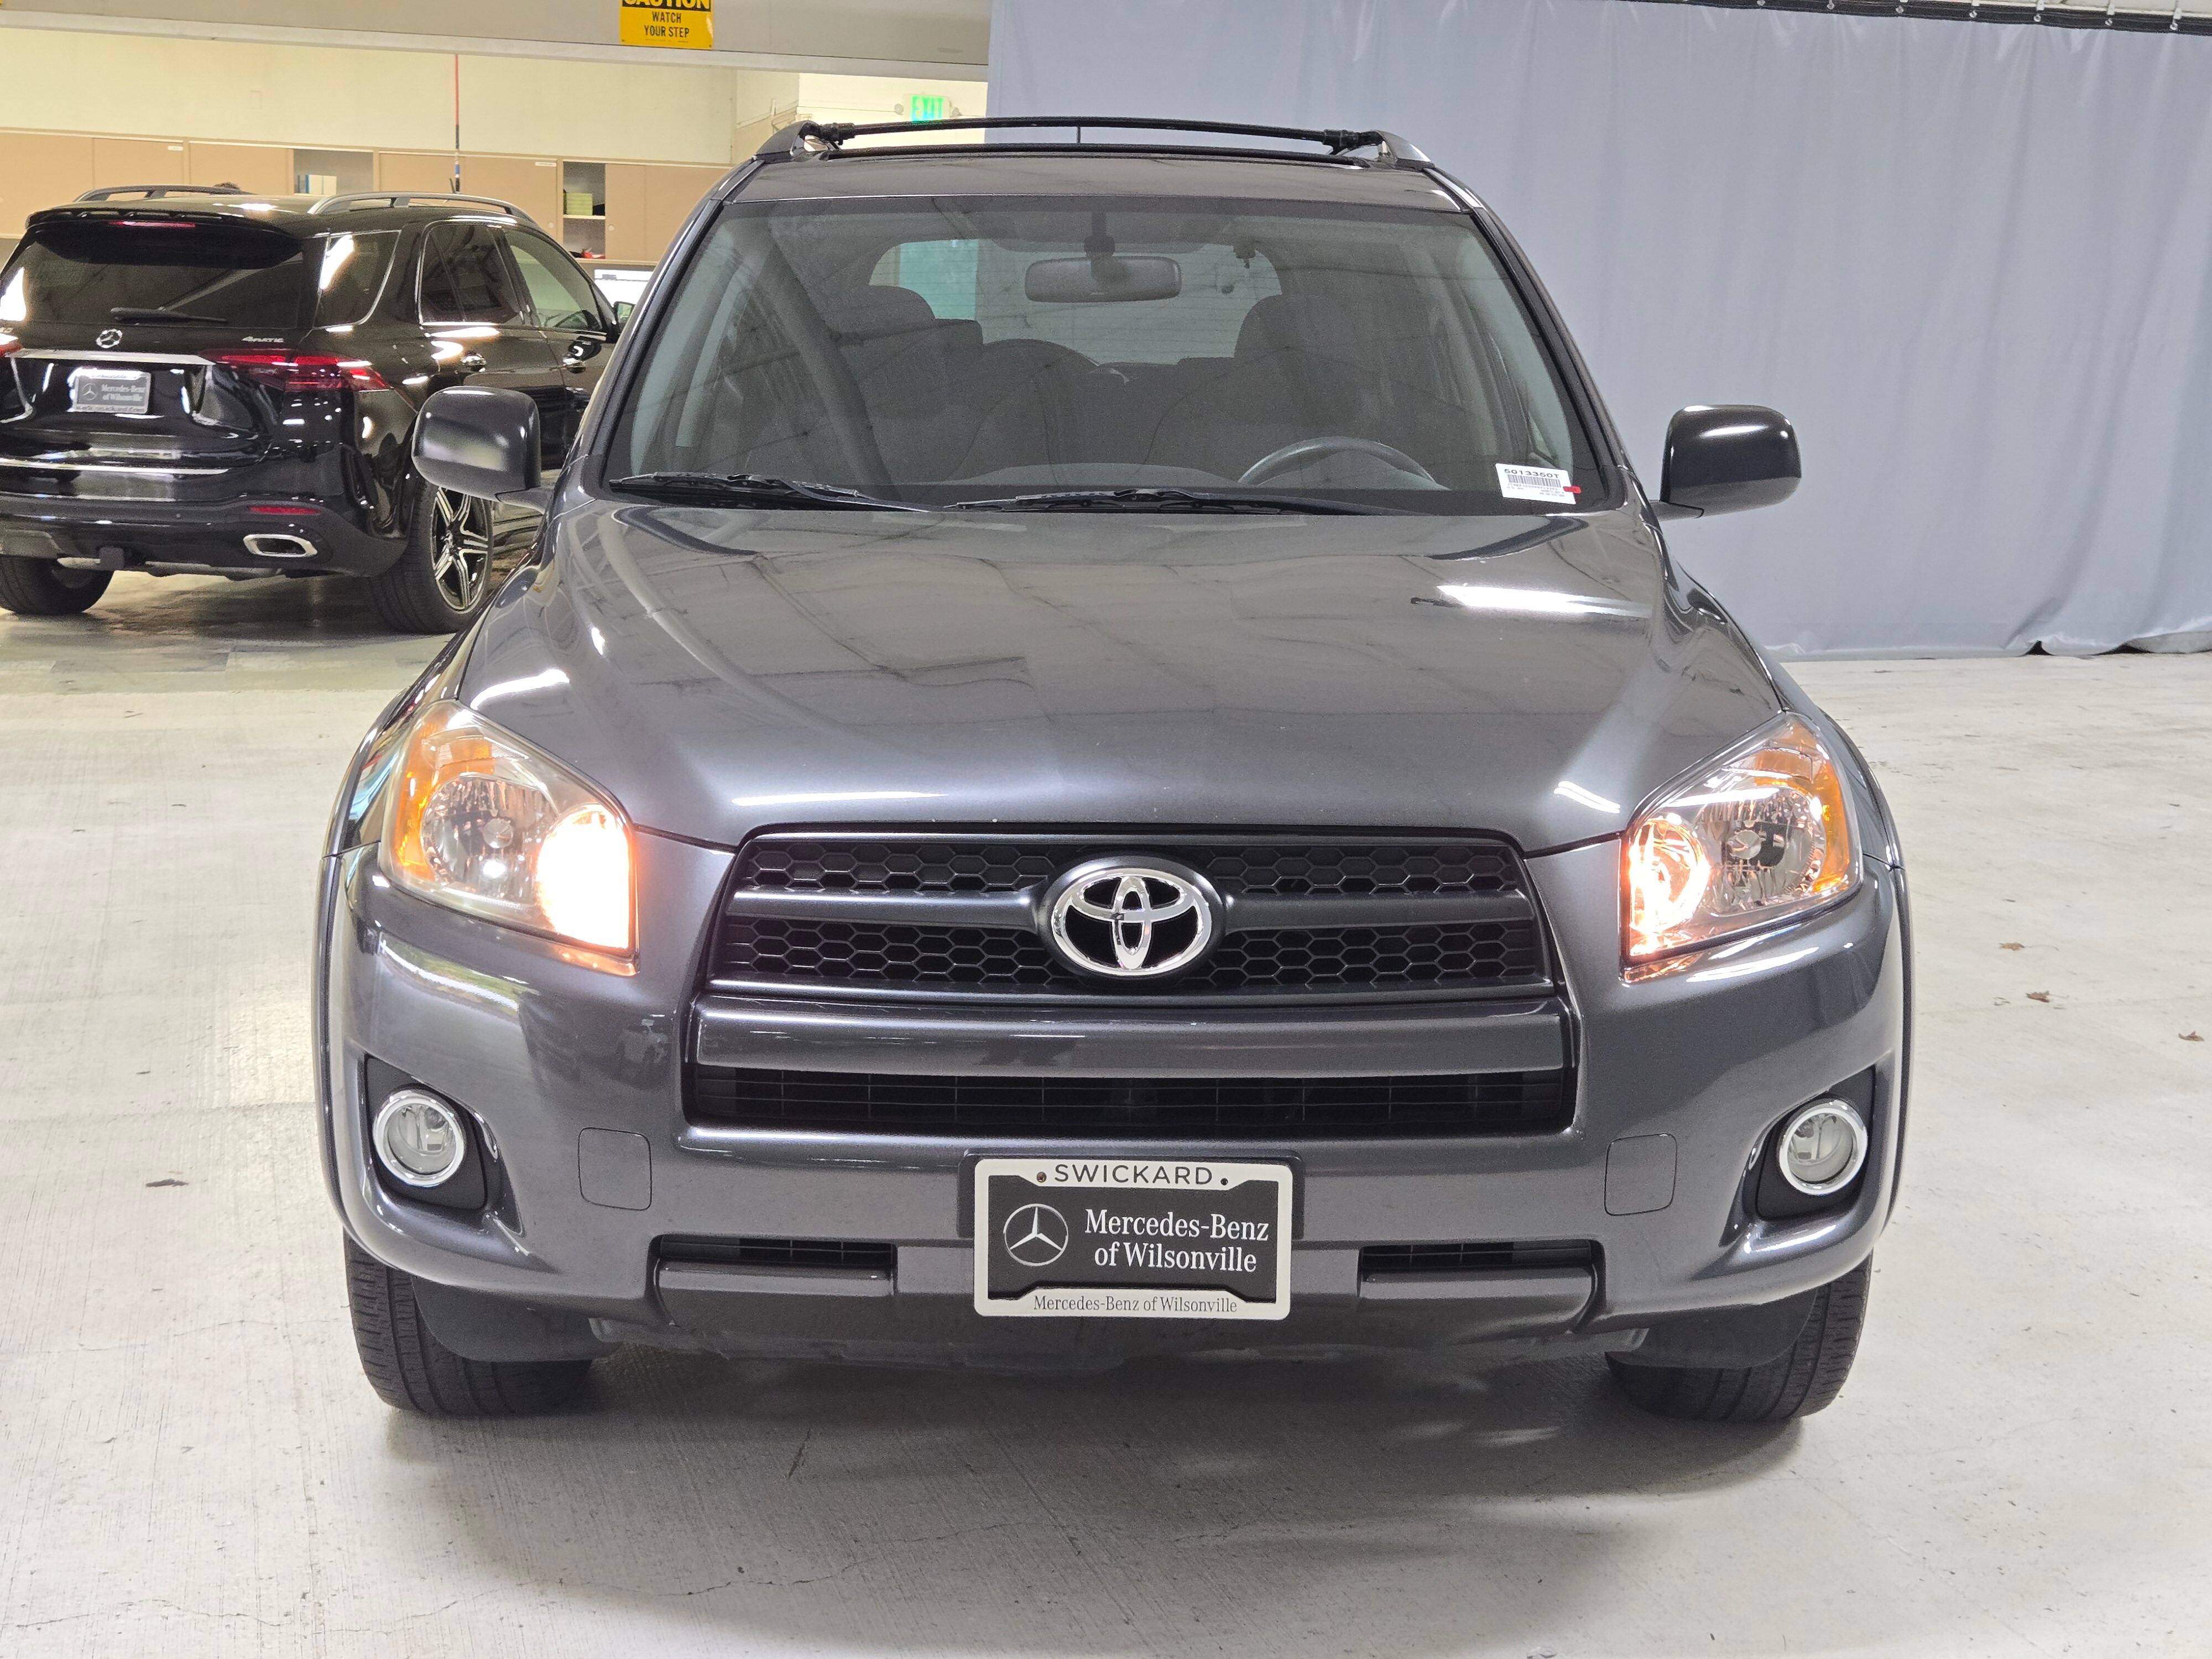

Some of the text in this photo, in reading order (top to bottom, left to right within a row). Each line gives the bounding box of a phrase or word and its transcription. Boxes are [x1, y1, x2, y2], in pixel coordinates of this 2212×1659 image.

[651, 11, 682, 23] WATCH
[644, 25, 690, 38] YOUR STEP
[912, 96, 943, 122] EXIT
[1054, 1164, 1212, 1185] SWICKARD
[1084, 1209, 1269, 1241] Mercedes-Benz
[1095, 1242, 1257, 1272] of Wilsonville
[1034, 1295, 1238, 1313] Mercedes-Benz of Wilsonville
